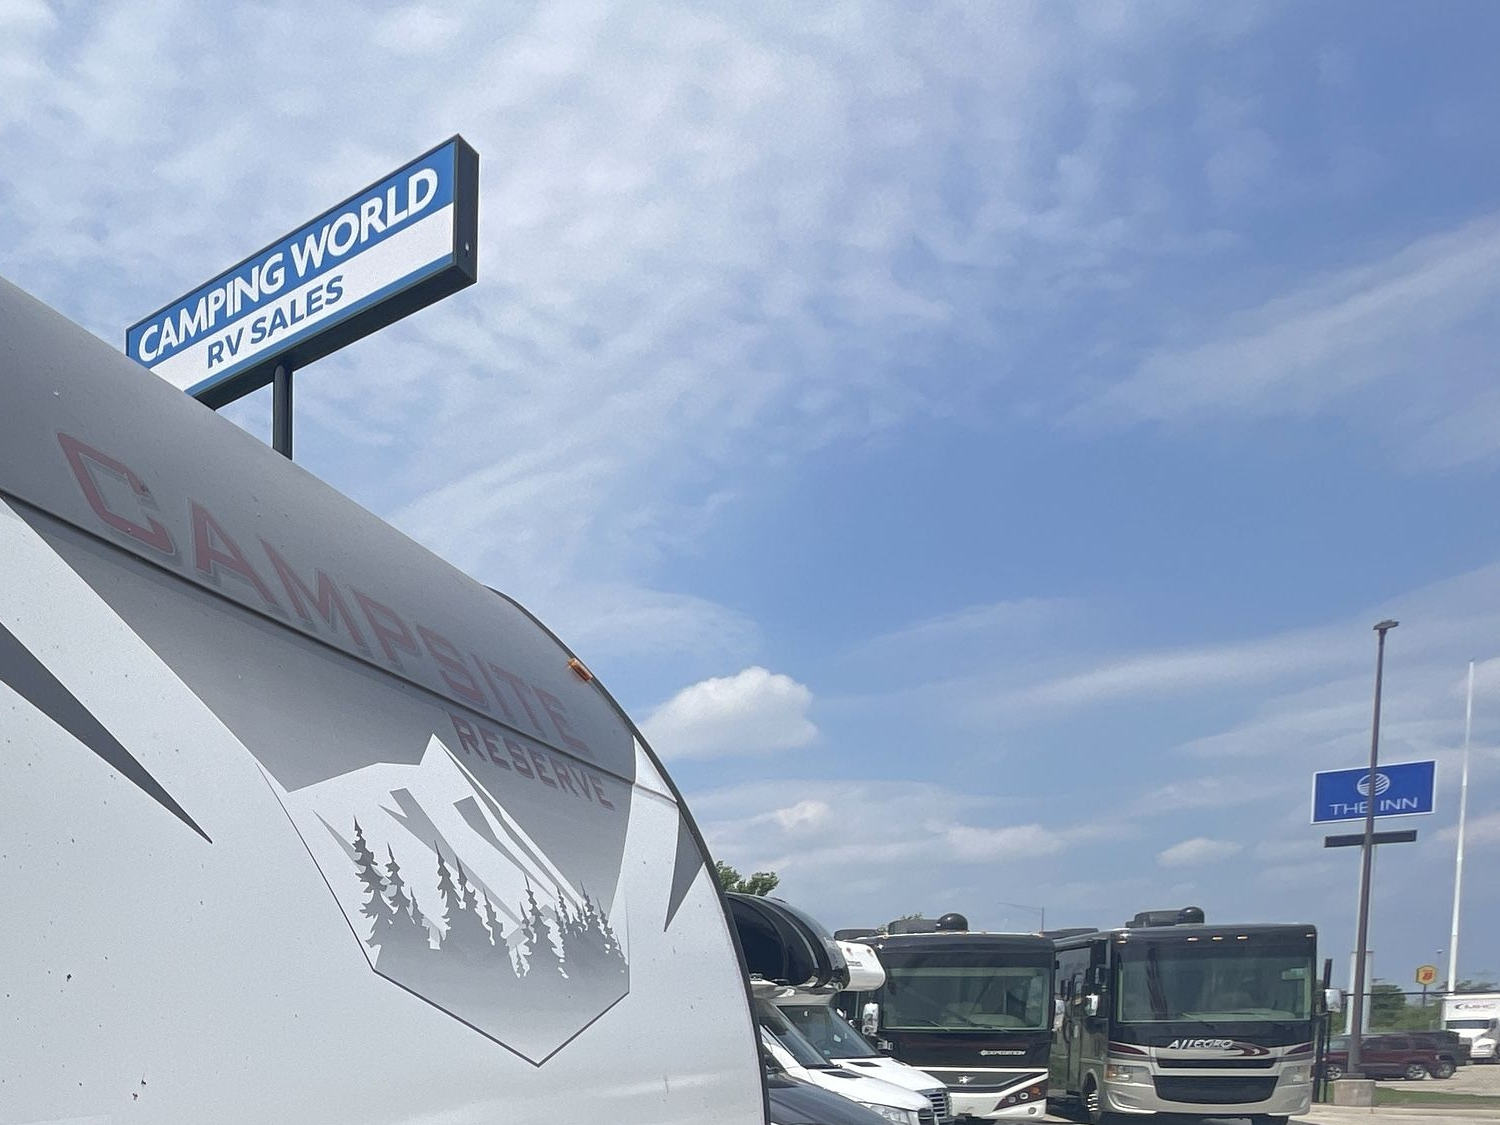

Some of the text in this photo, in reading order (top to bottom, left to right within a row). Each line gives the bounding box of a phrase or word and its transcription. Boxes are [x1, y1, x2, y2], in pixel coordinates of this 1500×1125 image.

[137, 167, 439, 363] CAMPING WORLD
[206, 274, 344, 369] RV SALES
[55, 431, 592, 755] CAMPSITE
[452, 711, 616, 812] RESERVE
[1329, 796, 1419, 816] THE INN
